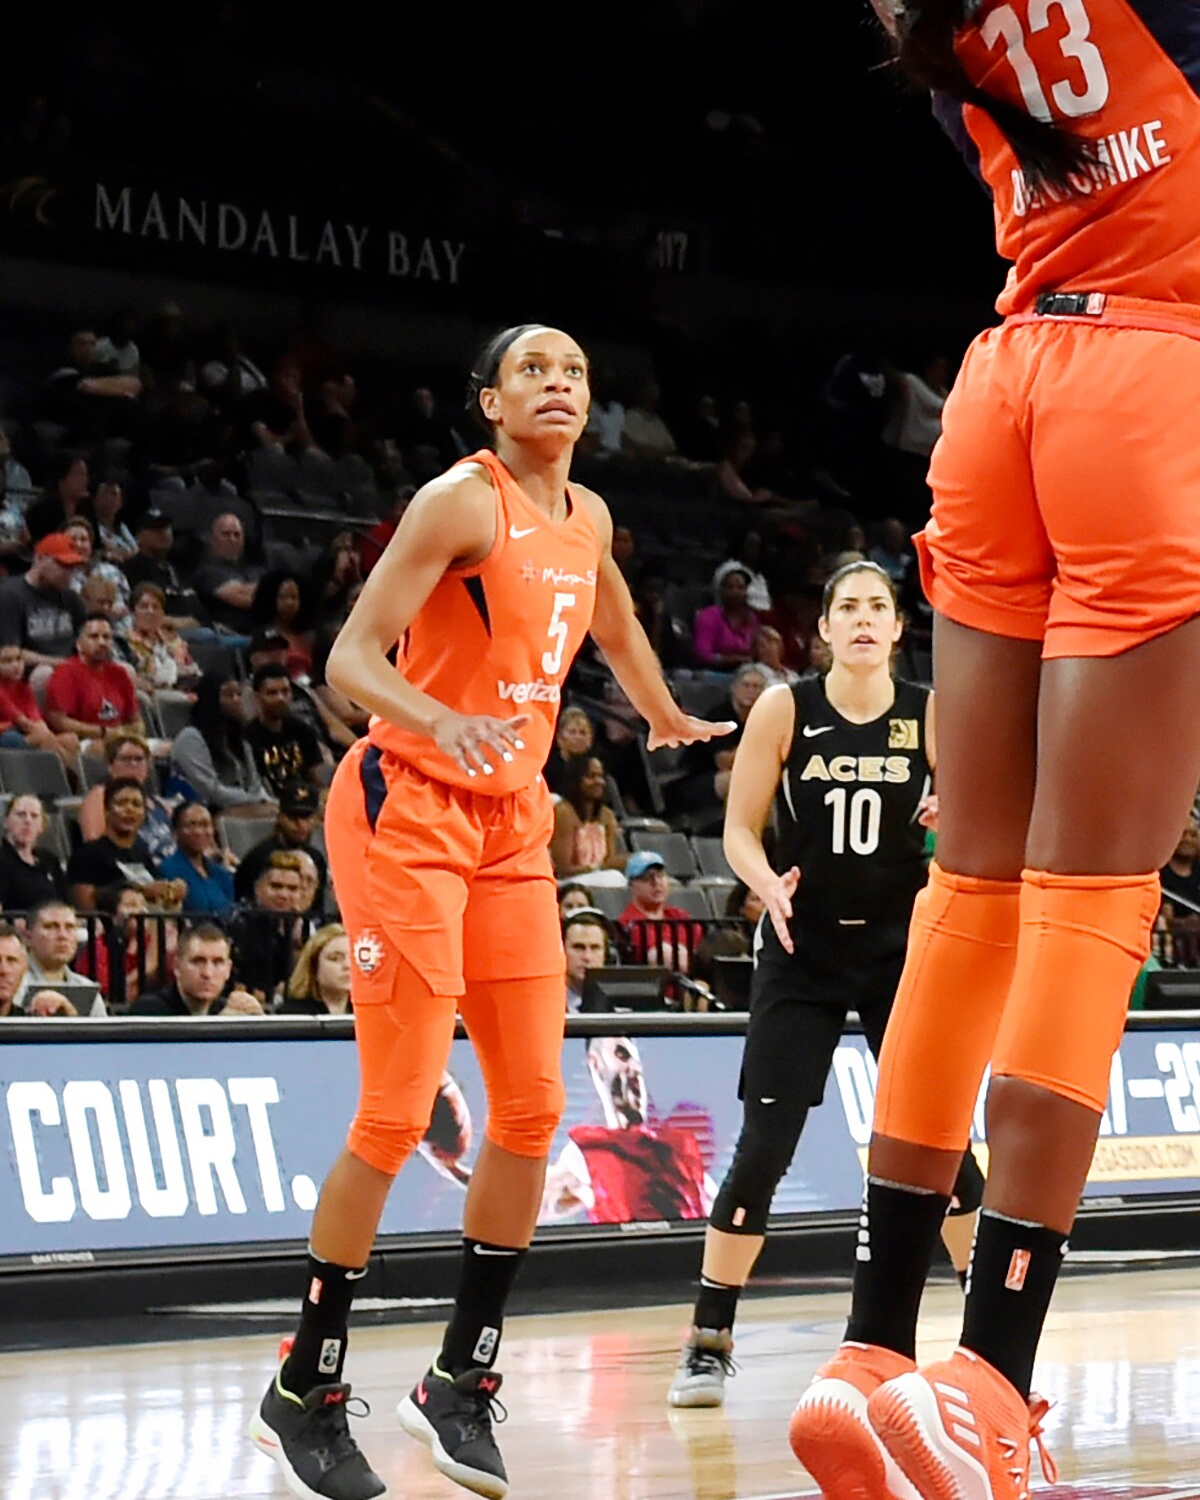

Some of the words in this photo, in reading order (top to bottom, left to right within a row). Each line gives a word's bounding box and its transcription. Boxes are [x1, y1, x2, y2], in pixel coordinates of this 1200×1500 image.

[94, 182, 369, 271] MANDALAY
[388, 230, 467, 285] BAY
[541, 592, 576, 675] 5
[497, 676, 562, 704] verizo
[800, 754, 911, 784] ACES
[823, 786, 883, 856] 10
[6, 1076, 319, 1223] COURT.
